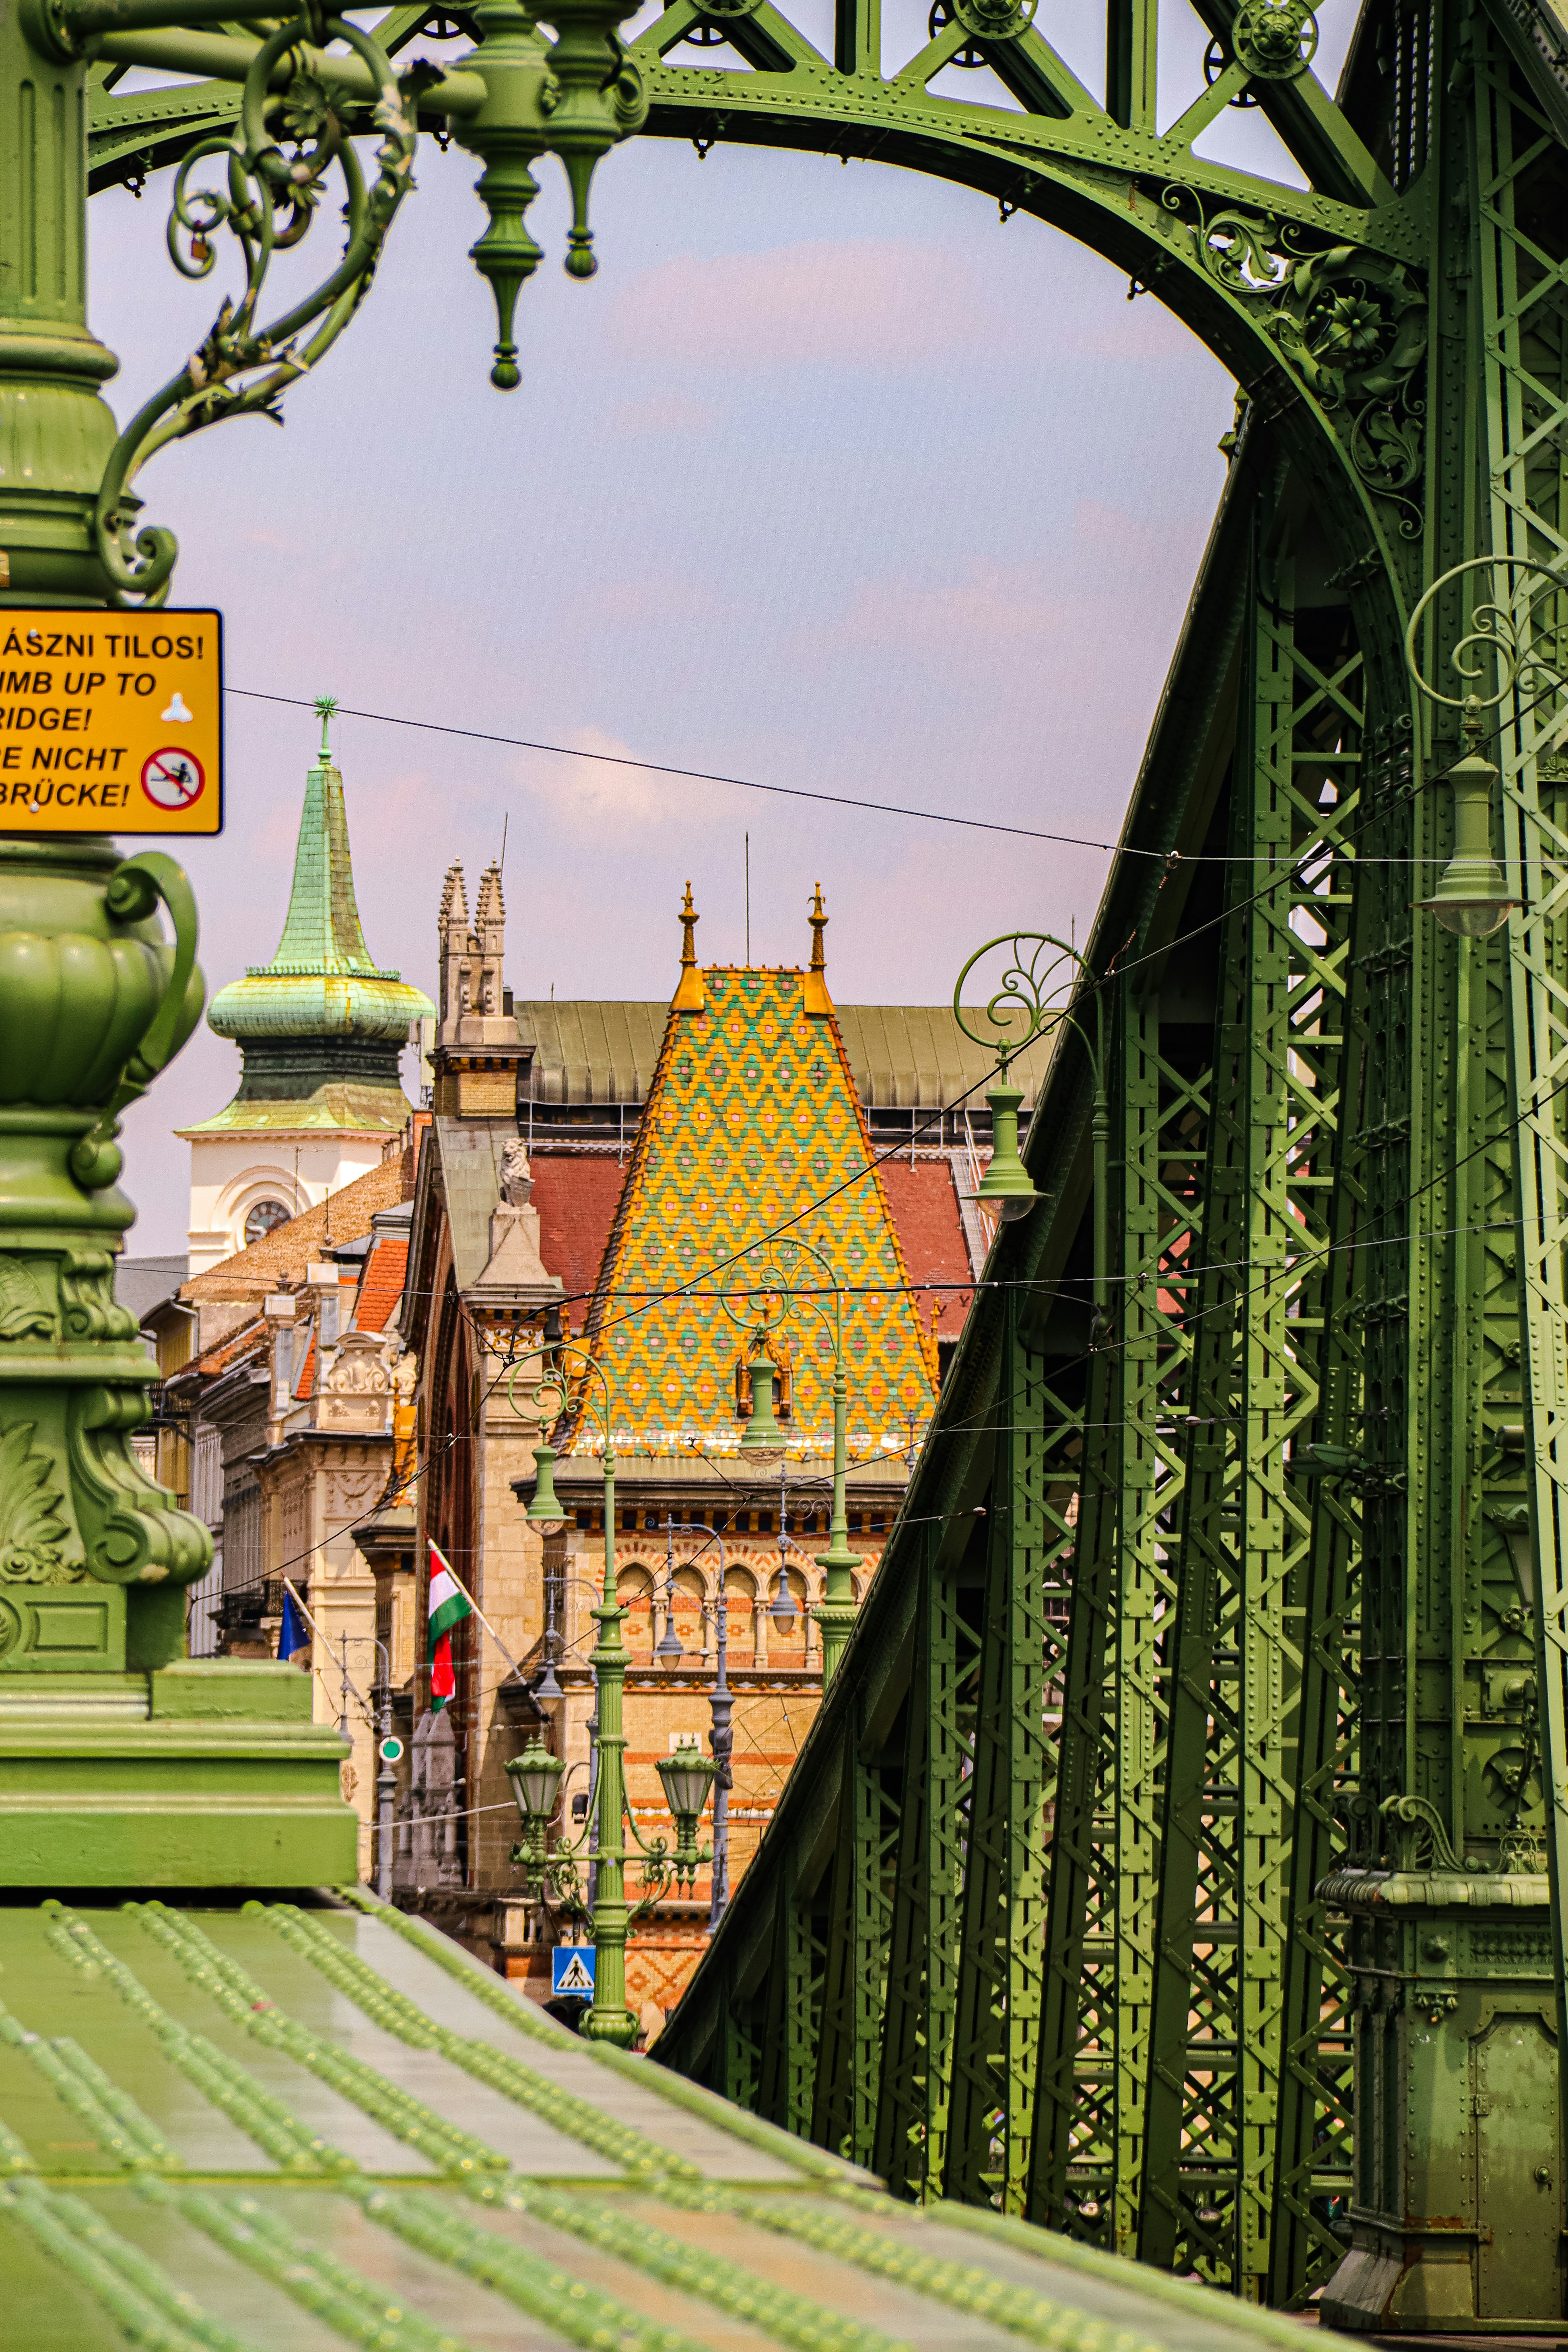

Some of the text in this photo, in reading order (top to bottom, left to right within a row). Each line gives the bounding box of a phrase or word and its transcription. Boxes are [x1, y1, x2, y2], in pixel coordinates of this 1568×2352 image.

[3, 628, 204, 660] ÁSZNI TILOS!
[64, 672, 106, 695] UP
[117, 673, 156, 696] TO
[0, 707, 92, 731] IDGE!
[32, 747, 128, 771] NICHT
